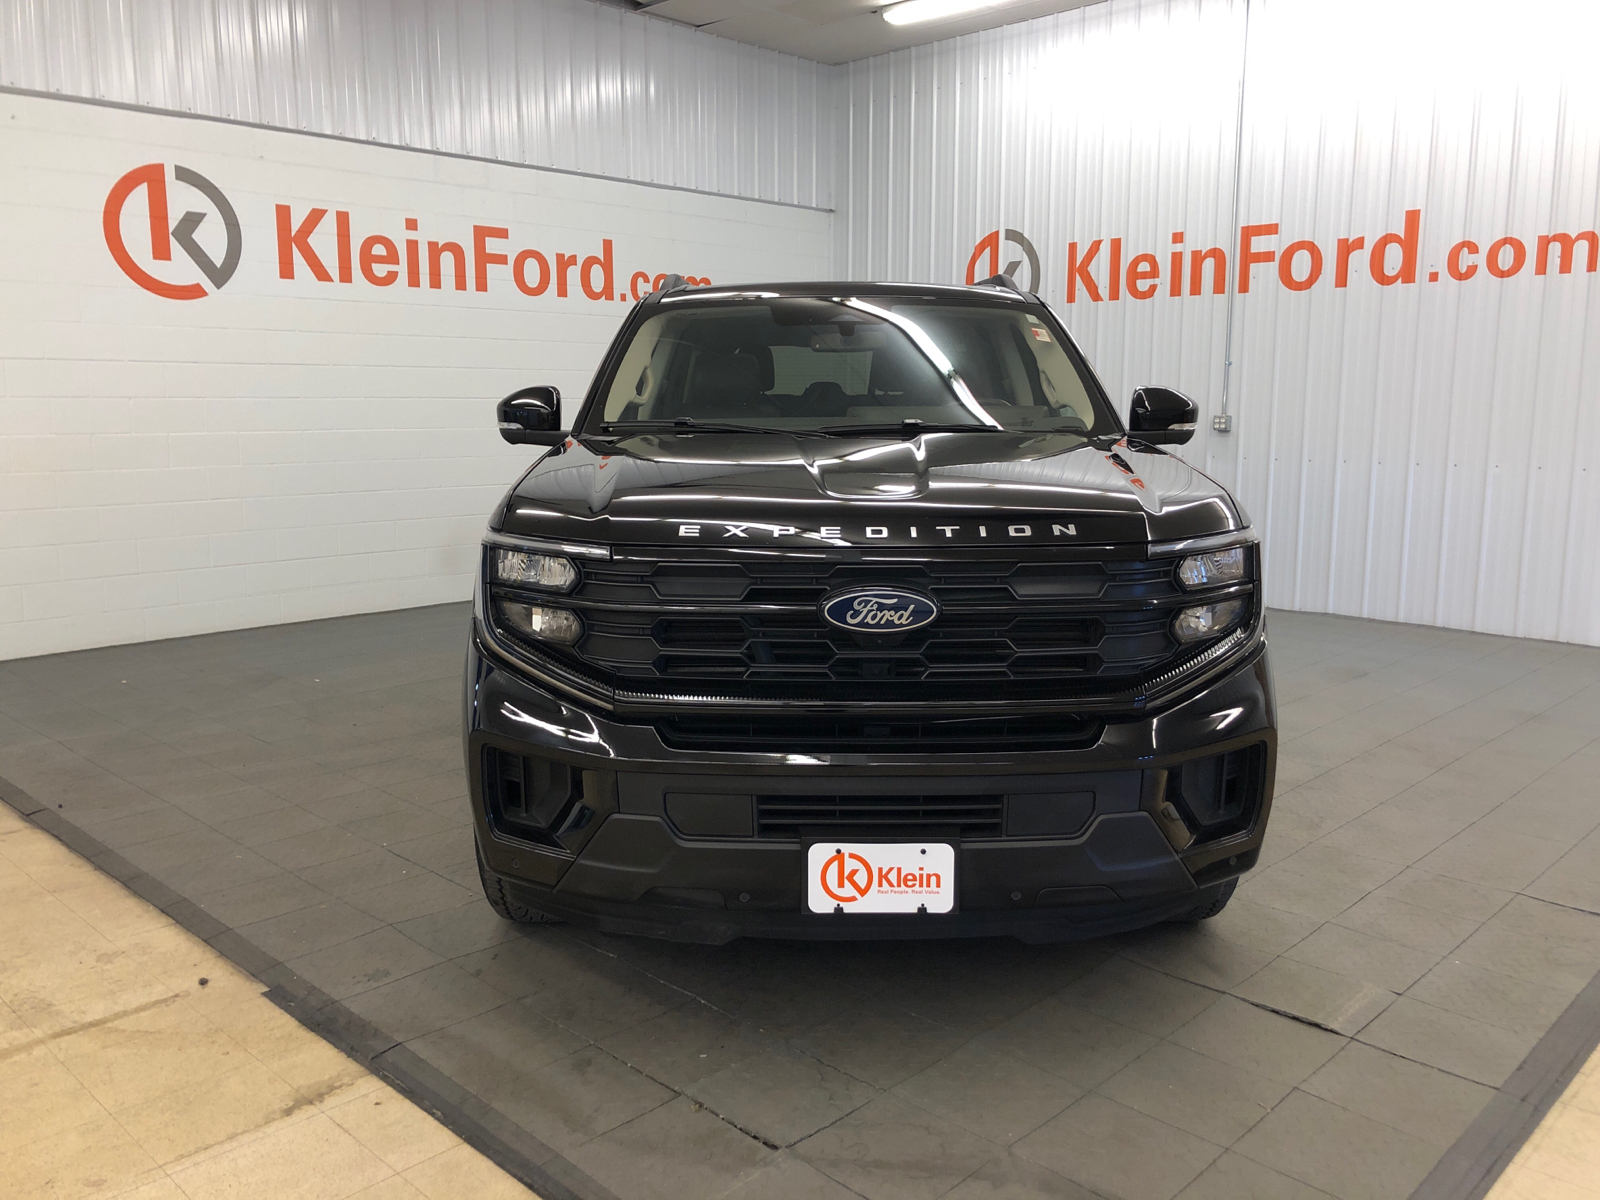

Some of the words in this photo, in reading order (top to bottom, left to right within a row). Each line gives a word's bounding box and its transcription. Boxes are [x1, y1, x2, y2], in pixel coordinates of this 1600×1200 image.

[1066, 208, 1599, 304] KleinFord.com
[677, 523, 1078, 540] EXPEDITION
[845, 597, 916, 625] Ford
[877, 866, 942, 889] Klein
